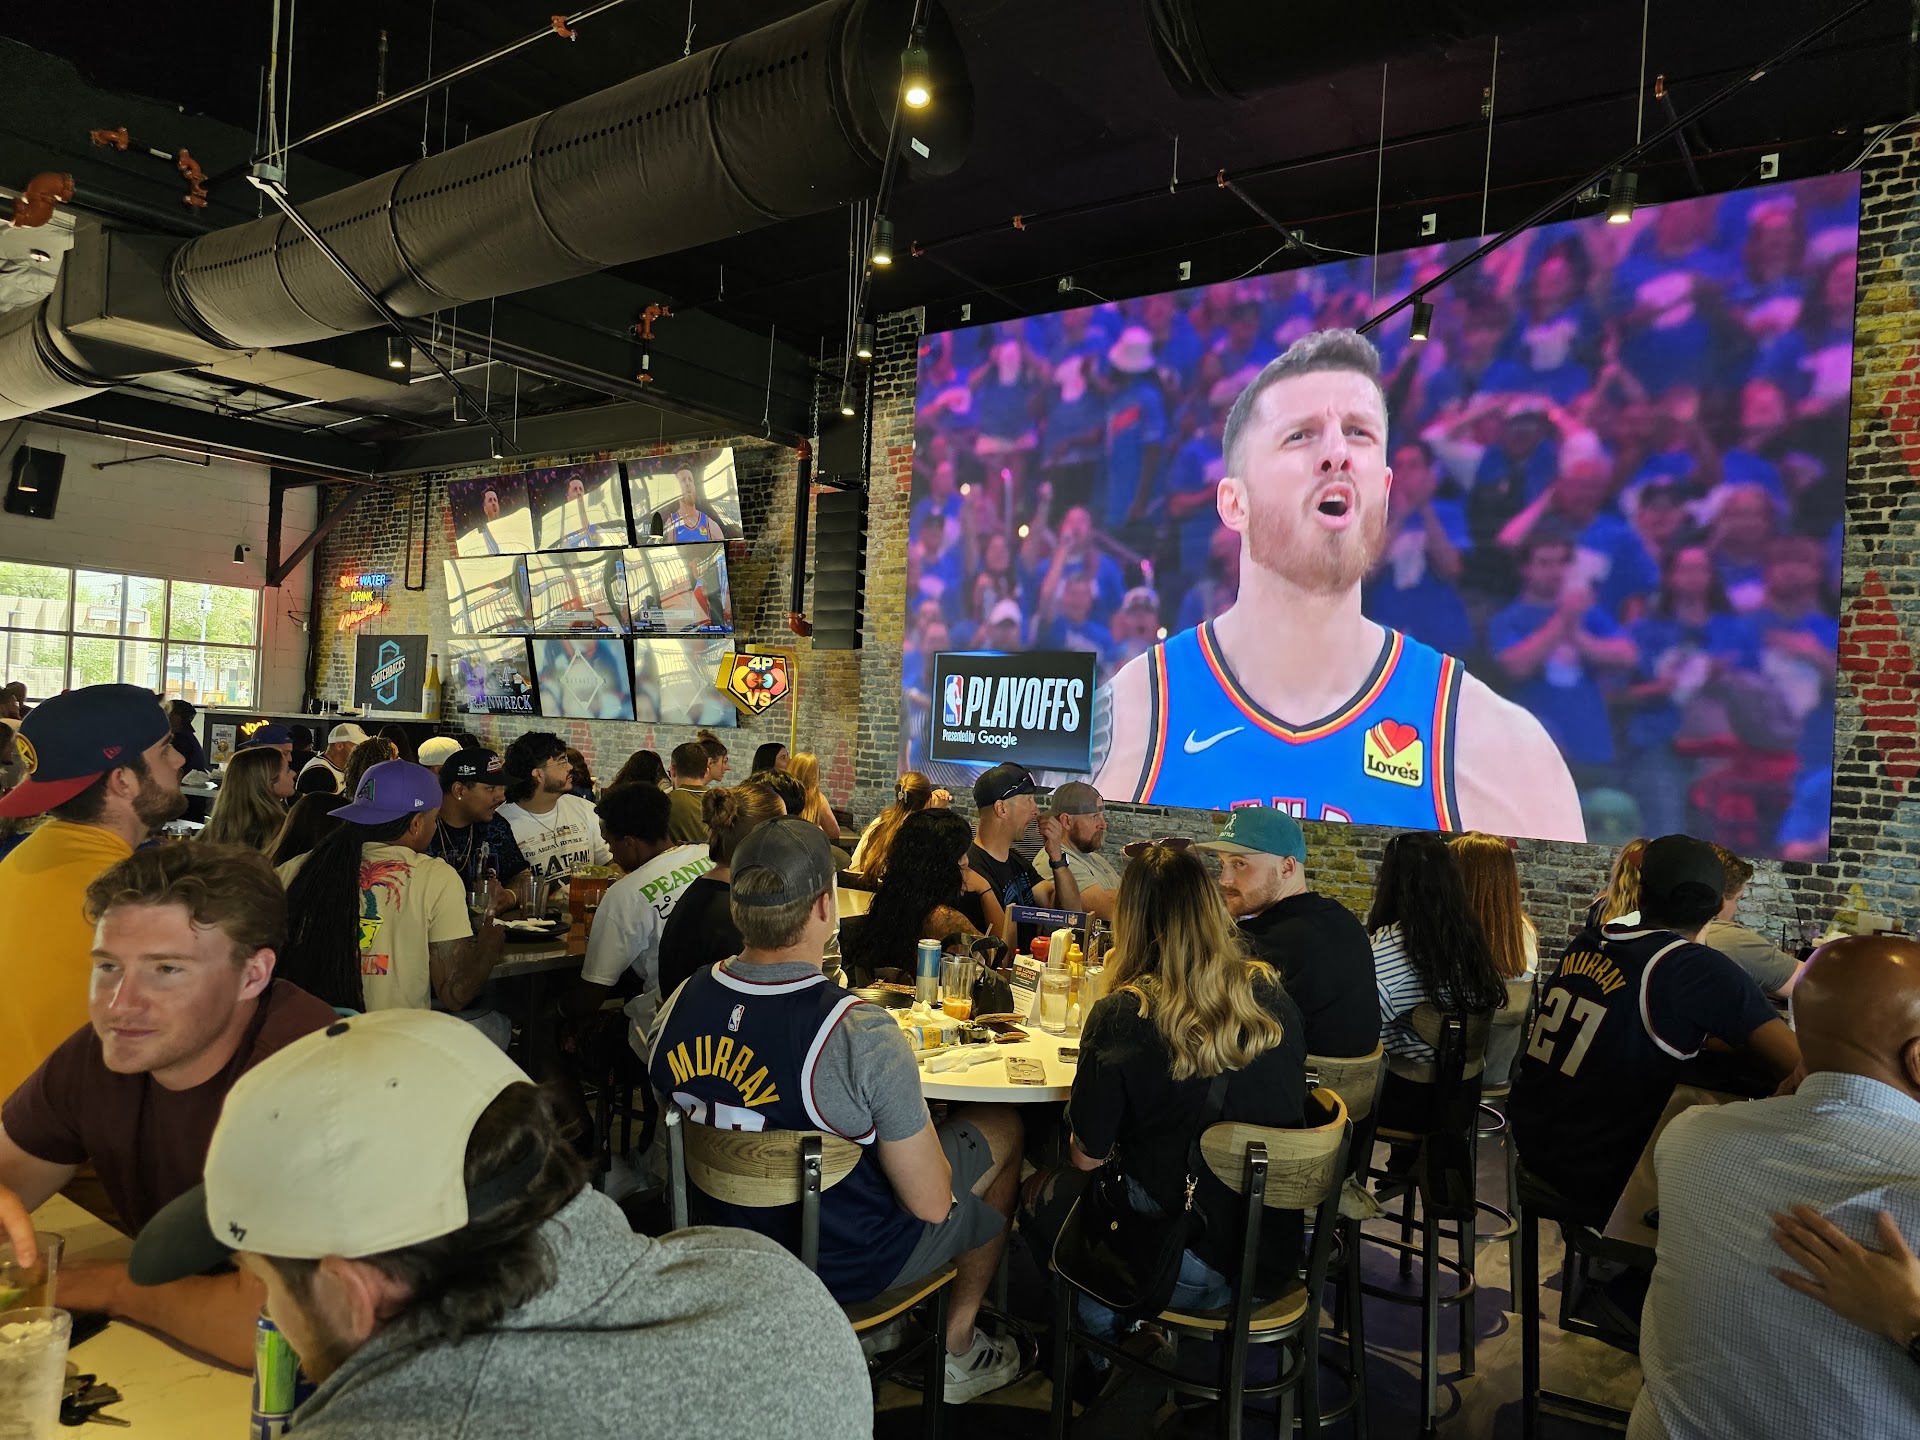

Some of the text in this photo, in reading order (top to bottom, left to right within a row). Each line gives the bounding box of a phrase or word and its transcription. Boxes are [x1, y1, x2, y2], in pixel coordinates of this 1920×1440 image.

[340, 574, 386, 588] SAVE WATER
[351, 591, 374, 602] DRINK
[338, 602, 384, 630] Whiskey
[371, 657, 406, 687] SWITCHBACKS
[748, 656, 774, 672] 4P
[465, 694, 533, 710] TRAINWRECK
[746, 690, 771, 707] VS
[964, 676, 1084, 732] PLAYOFFS
[942, 728, 1018, 749] Presented by Google
[1559, 950, 1627, 996] MURRAY
[1526, 986, 1608, 1077] 27
[666, 1034, 780, 1108] MURRAY
